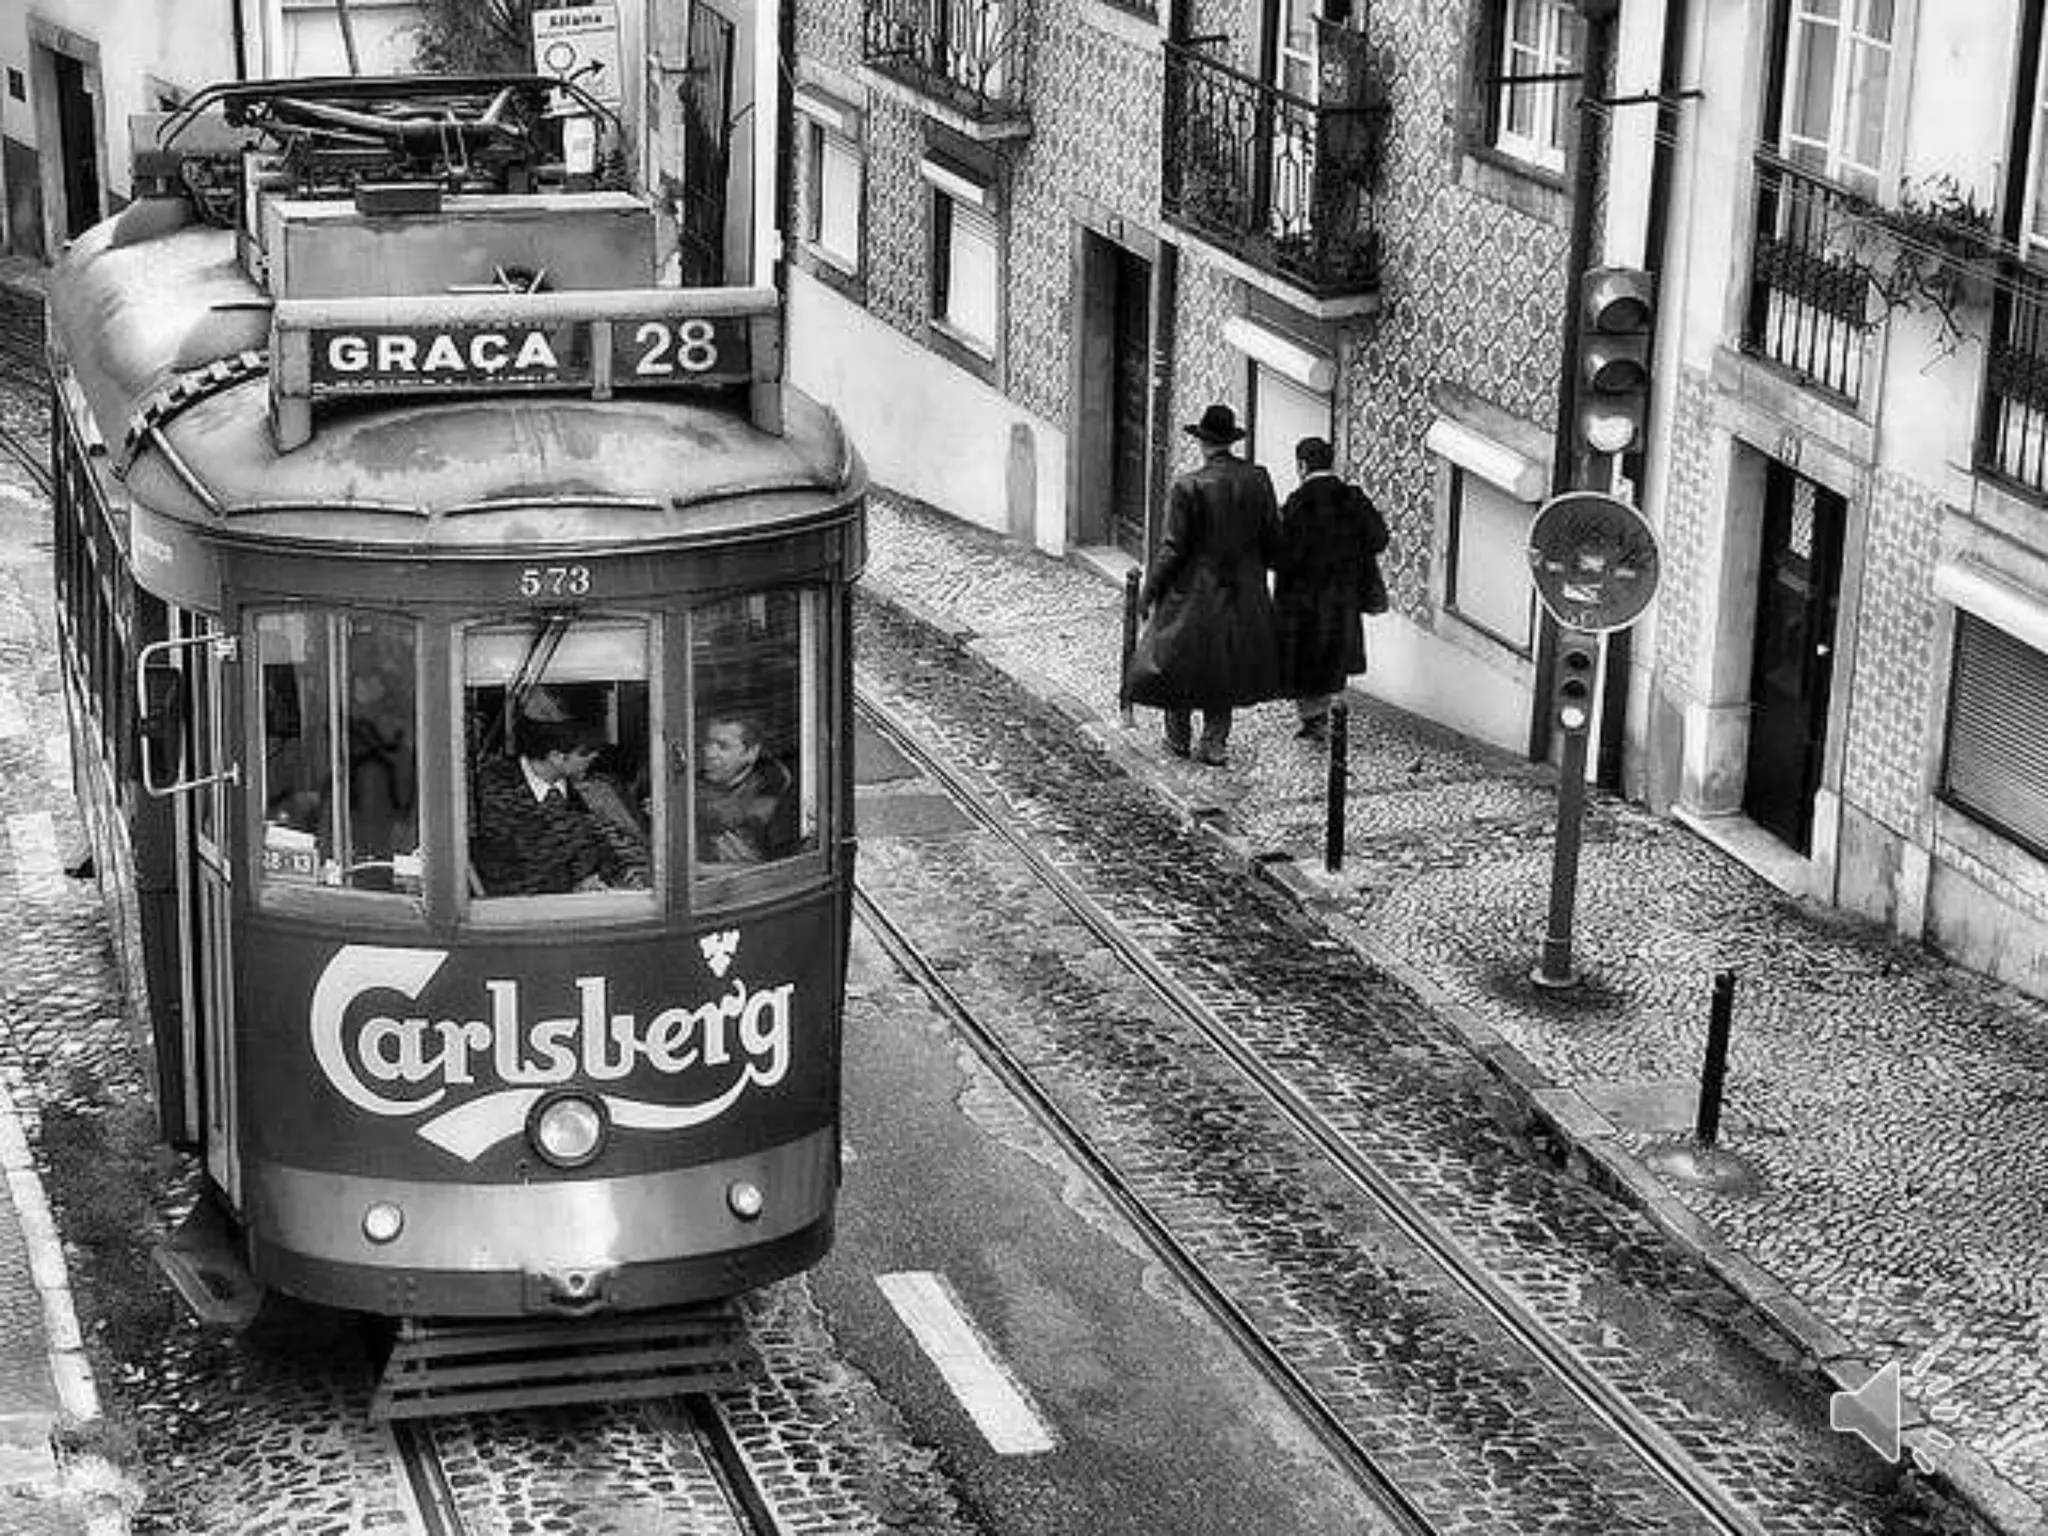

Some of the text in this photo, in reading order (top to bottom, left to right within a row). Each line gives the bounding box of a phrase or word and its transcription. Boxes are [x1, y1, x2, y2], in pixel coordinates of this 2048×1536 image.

[327, 319, 718, 375] GRAÇA 28
[520, 566, 590, 596] 573
[310, 944, 795, 1116] Carlsberg
